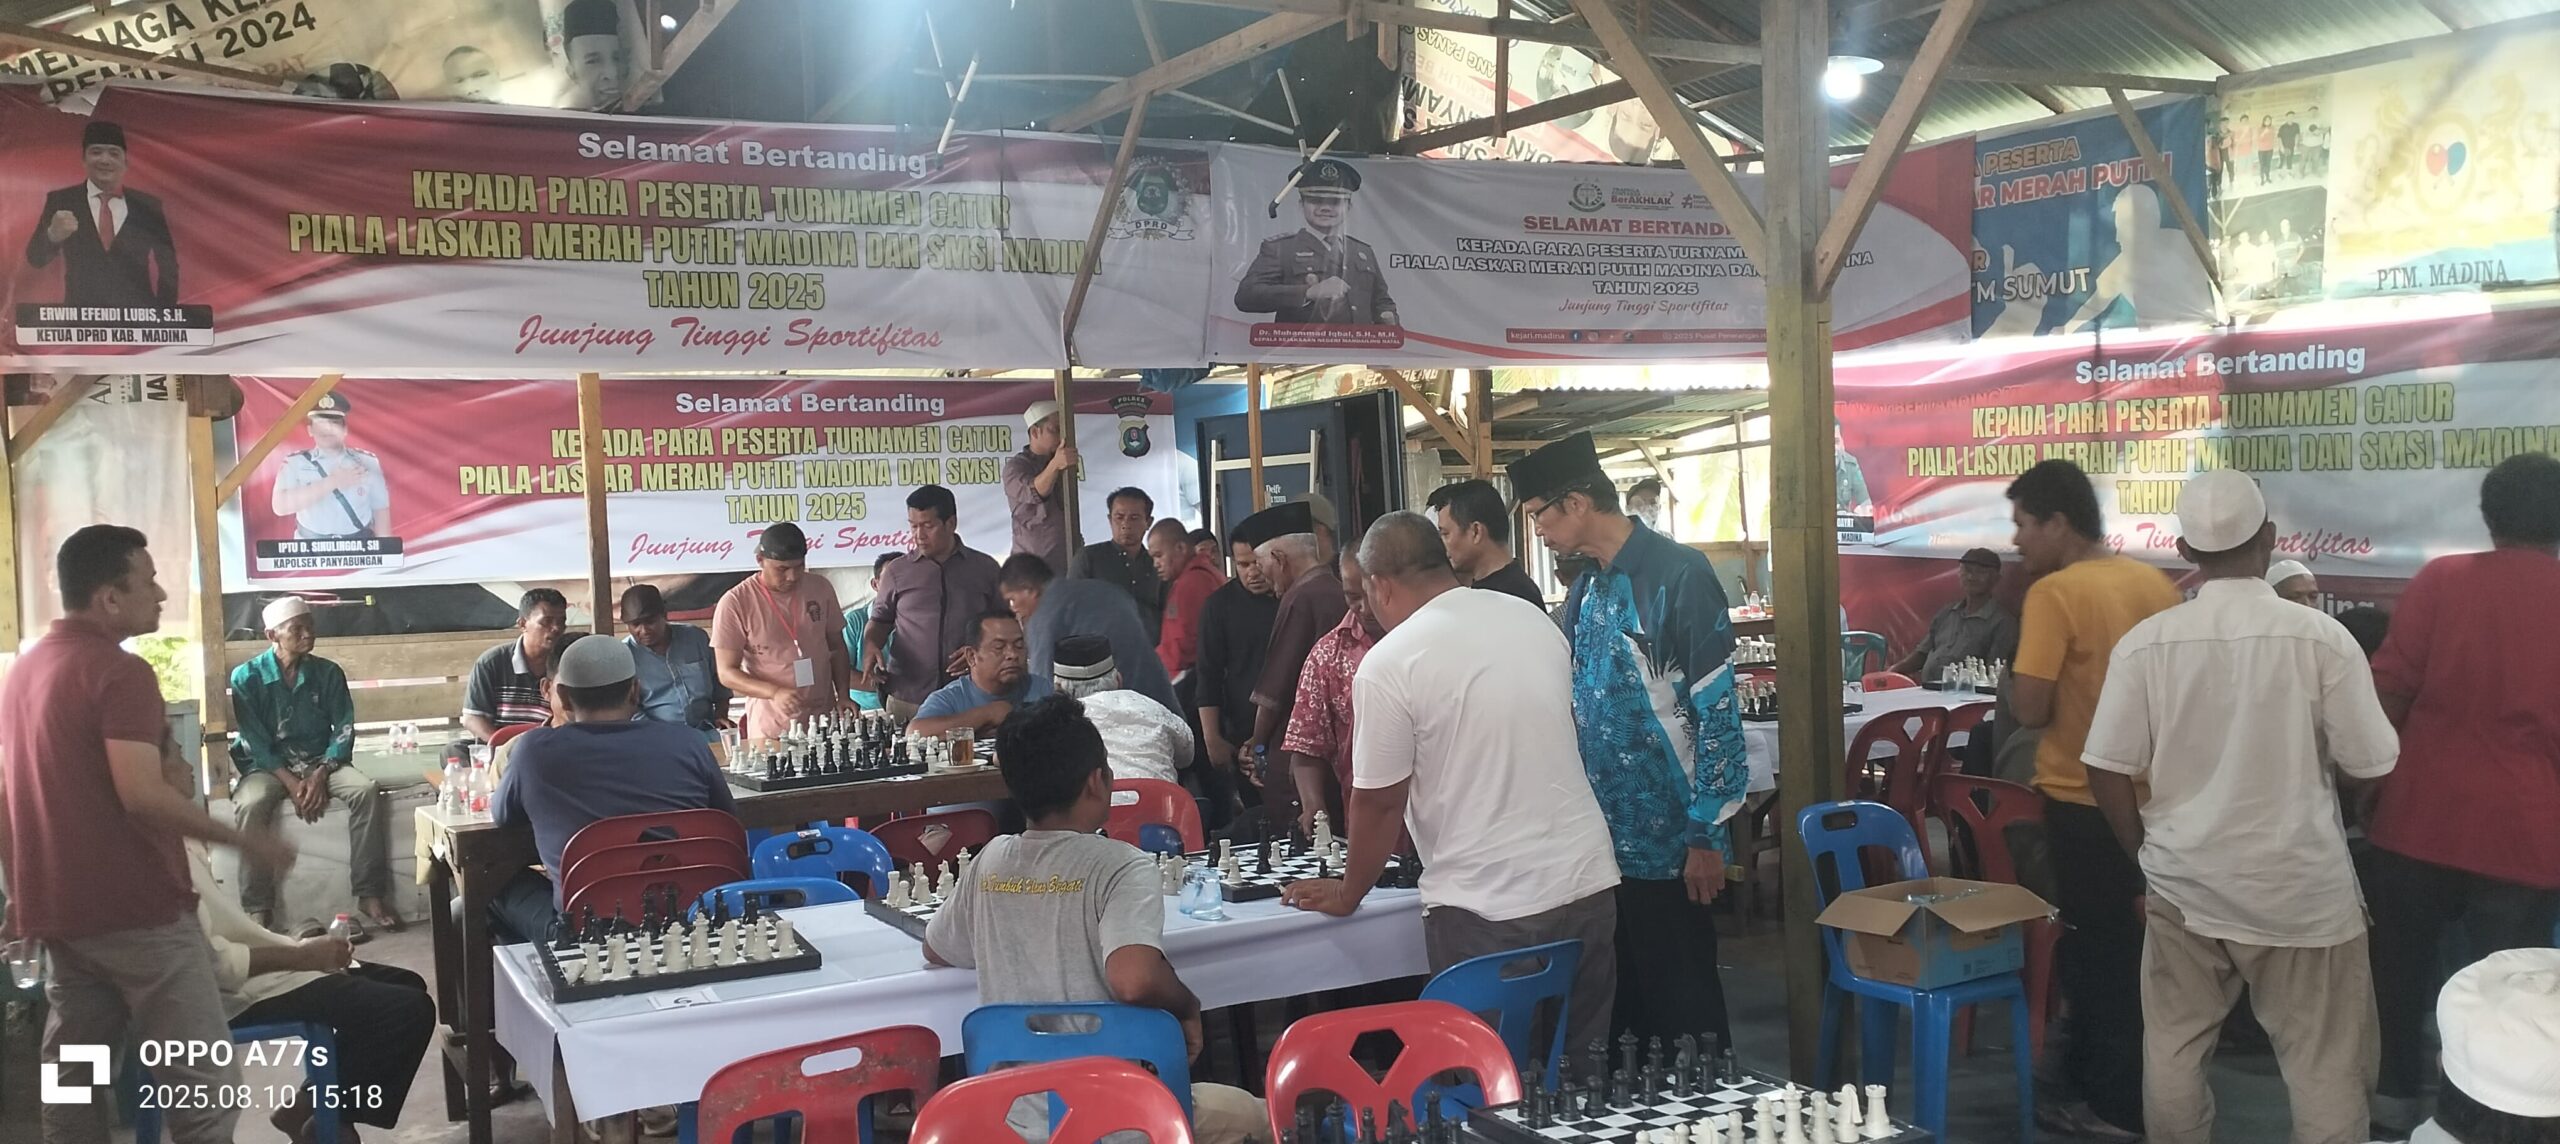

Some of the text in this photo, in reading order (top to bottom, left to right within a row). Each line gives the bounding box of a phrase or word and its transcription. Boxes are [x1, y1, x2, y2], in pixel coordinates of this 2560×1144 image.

[216, 2, 317, 58] 2024
[578, 131, 927, 179] Selamat Bertanding
[1984, 137, 2081, 176] PESERTA
[411, 170, 1011, 230] KEPADA PARA PESERTA TURNAMEN CATUR
[1611, 195, 1672, 205] BerAKHLAK
[2000, 166, 2086, 207] MERAH
[1135, 220, 1168, 230] DPRD
[1523, 215, 1731, 236] SELAMAT BERTAND
[288, 213, 388, 255] PIALA
[397, 217, 523, 259] LASKAR
[531, 222, 644, 262] MERAH
[652, 226, 736, 265] PUTIH
[743, 228, 858, 269] MADINA
[866, 232, 921, 270] DAN
[927, 234, 996, 272] SMSI
[1456, 237, 1748, 260] KEPADA PARA PESERTA TURNAM
[1390, 254, 1449, 270] PIALA
[1453, 257, 1526, 274] LASKAR
[1530, 260, 1595, 276] MERAH
[1599, 261, 1650, 277] PUTIH
[1654, 262, 1727, 278] MADINA
[2377, 258, 2509, 291] PTM. MADINA
[643, 270, 825, 310] TAHUN 2025
[1593, 280, 1699, 296] TAHUN 2025
[2003, 267, 2090, 301] SUMUT
[39, 307, 187, 323] ERWIN EFENDI LUBIS, S.H.
[1559, 299, 1729, 316] Junjung Tinggi Sportifitas
[36, 329, 188, 343] KETUA DPRD KAB. MADINA
[515, 314, 943, 356] Junjung Tinggi Sportifitas
[1273, 329, 1327, 337] Muhammad
[1328, 330, 1354, 338] Iqbal,
[1510, 331, 1566, 341] kejari.madina
[2075, 357, 2188, 384] Selamat
[2196, 344, 2366, 376] Bertanding
[676, 392, 945, 416] Selamat Bertanding
[1972, 382, 2455, 438] KEPADA PARA PESERTA TURNAMEN CATUR
[551, 425, 1012, 458] KEADA PARA PESERTA TURNAMEN CATUR
[1907, 446, 1958, 477] PIALA
[1963, 443, 2038, 476] LASKAR
[2124, 438, 2188, 475] PUTIH
[2193, 434, 2293, 473] MADINA
[2299, 432, 2353, 472] DAN
[2359, 430, 2435, 470] SMSI
[459, 465, 533, 495] PIALA
[539, 463, 634, 494] LASAR
[640, 462, 726, 493] MERAH
[732, 461, 797, 490] PUTIH
[803, 458, 892, 488] MADINA
[898, 458, 941, 486] DAN
[946, 457, 1001, 485] SMSI
[725, 492, 867, 524] TAHUN 2025
[273, 556, 383, 569] KAPOLSEK PANYABUNGAN
[278, 542, 299, 553] IPTU
[300, 542, 310, 553] D.
[367, 540, 380, 551] SH
[628, 533, 735, 564] Junjung
